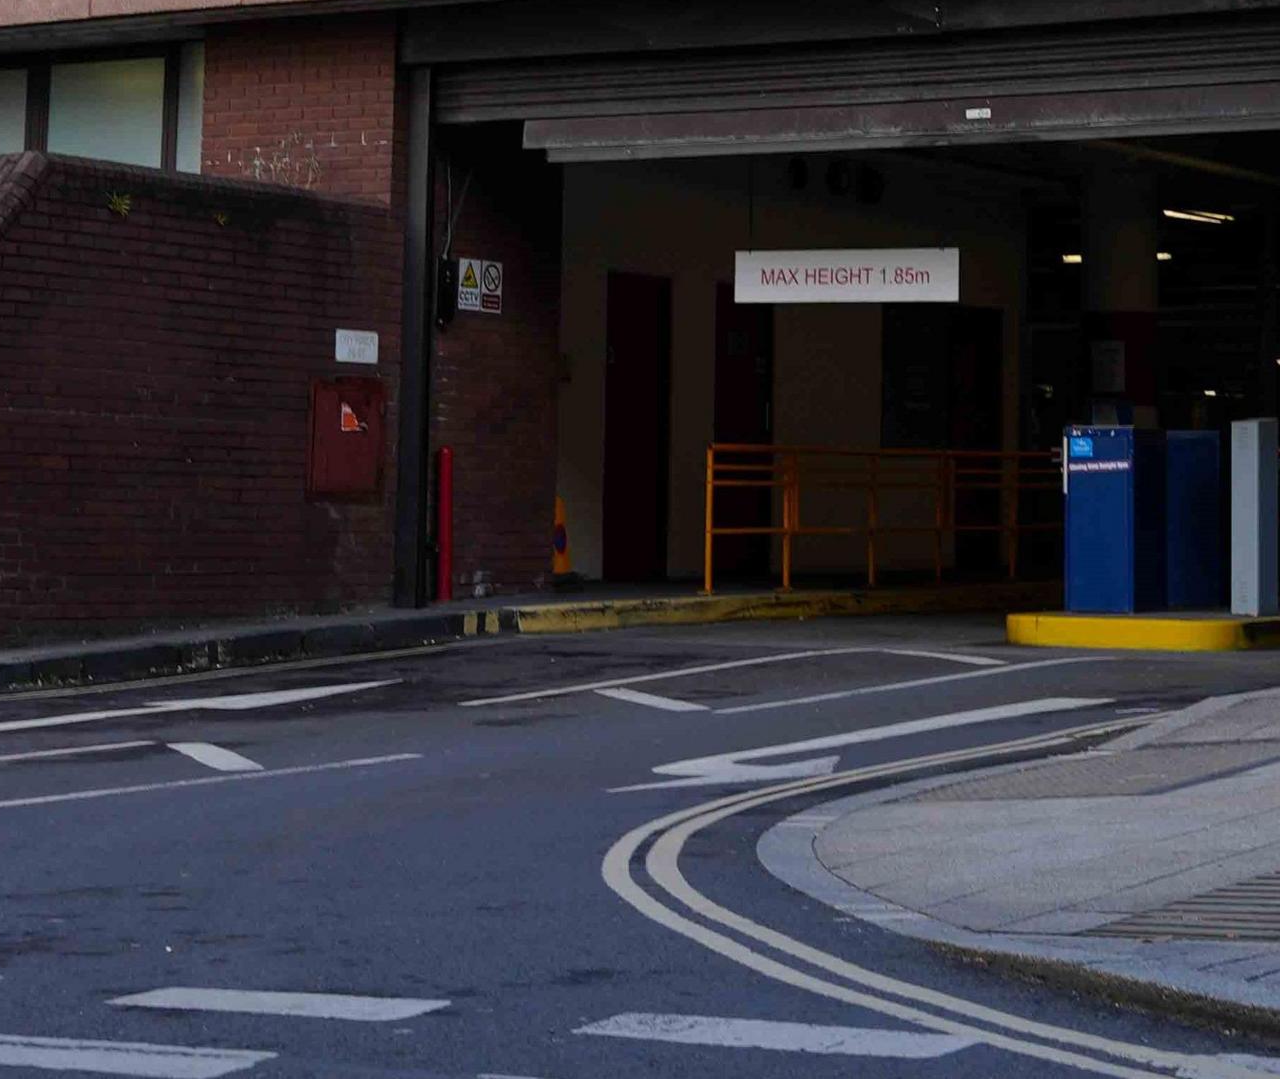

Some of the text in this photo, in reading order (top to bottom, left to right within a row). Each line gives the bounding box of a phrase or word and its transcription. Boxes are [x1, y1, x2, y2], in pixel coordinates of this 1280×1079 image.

[761, 267, 930, 285] MAX HEIGHT 1.85m
[460, 291, 479, 302] CCTV
